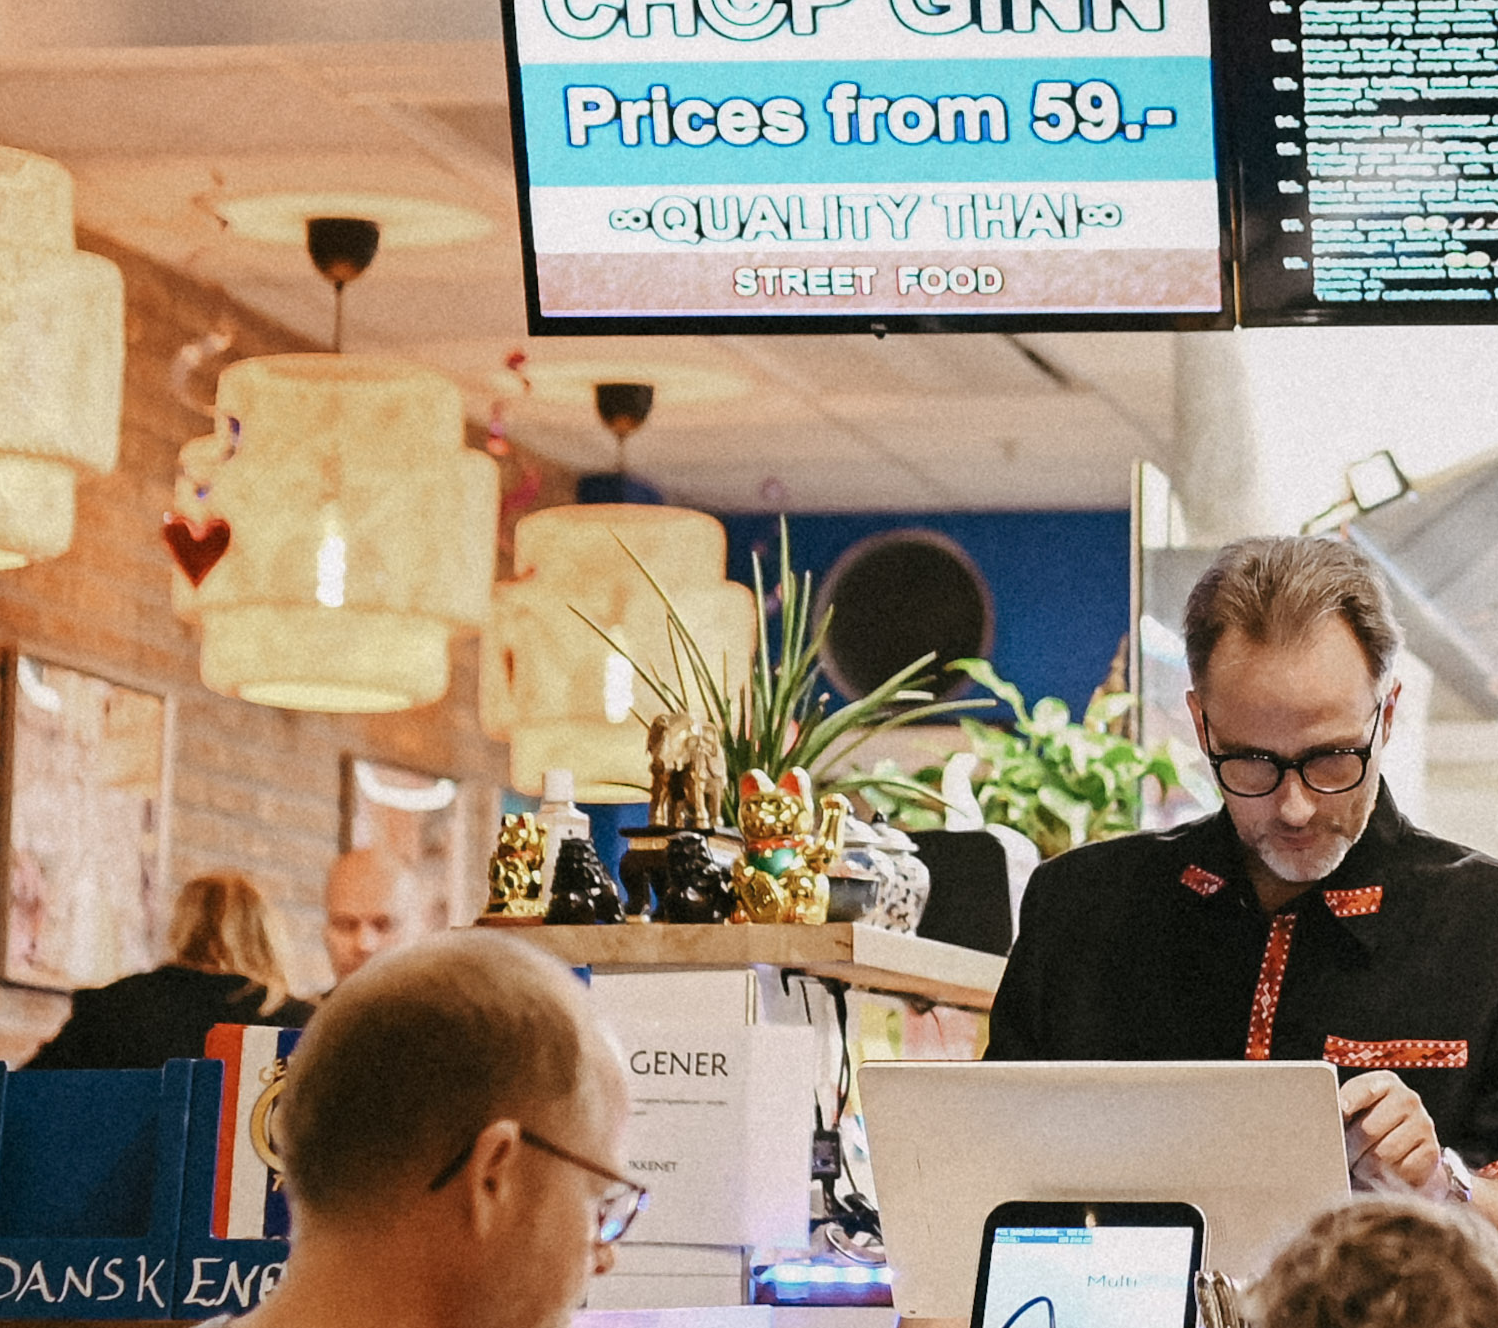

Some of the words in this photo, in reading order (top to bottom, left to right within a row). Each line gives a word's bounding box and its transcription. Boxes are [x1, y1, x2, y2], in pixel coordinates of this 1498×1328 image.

[564, 85, 806, 147] Prices
[824, 81, 1007, 145] from
[1032, 80, 1175, 141] 59.-
[734, 267, 877, 296] STREET
[898, 267, 1004, 295] FOOD
